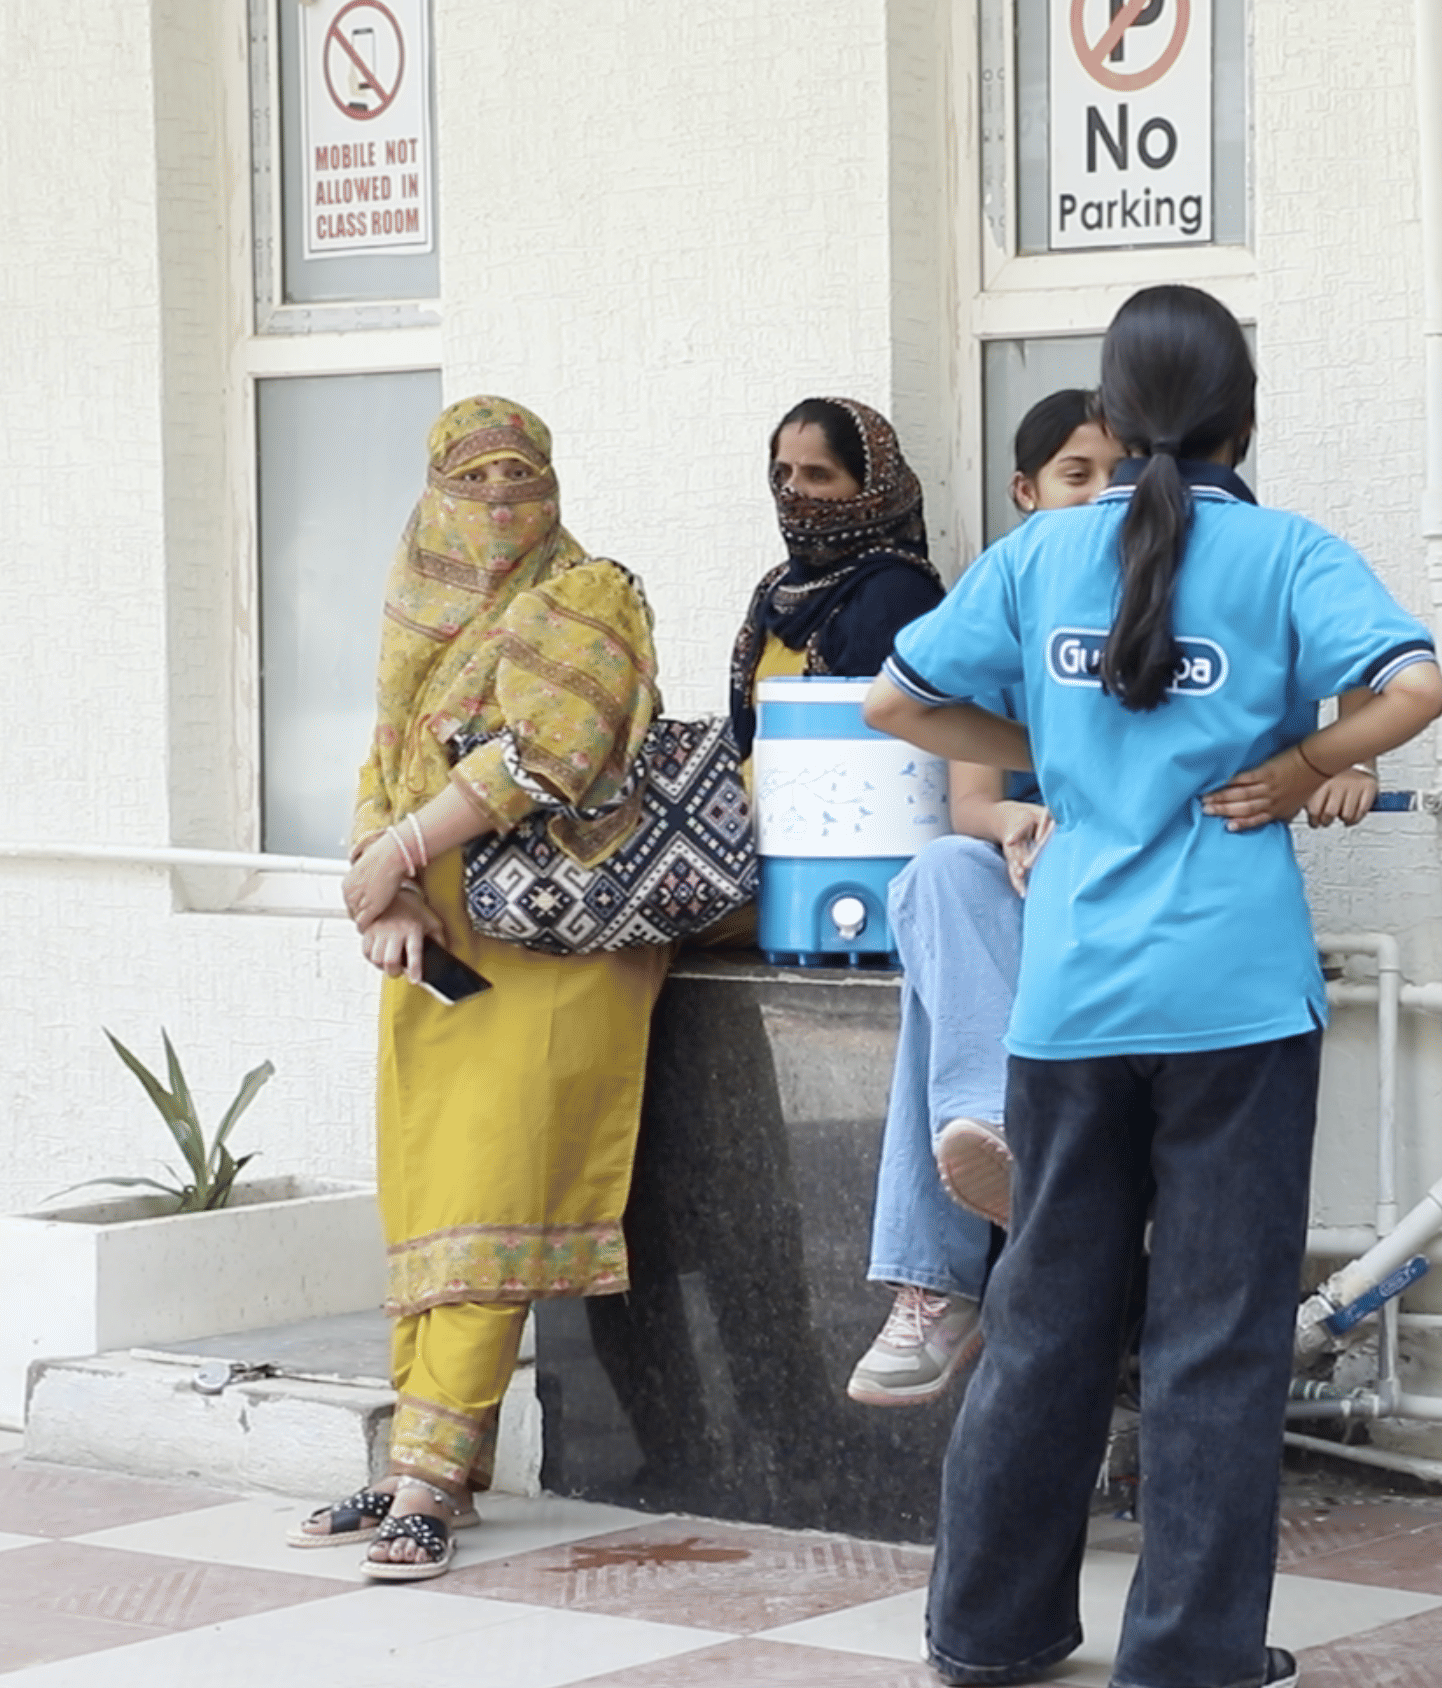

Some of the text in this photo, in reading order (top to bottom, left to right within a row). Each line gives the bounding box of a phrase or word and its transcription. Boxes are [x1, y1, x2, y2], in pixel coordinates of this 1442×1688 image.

[1086, 102, 1178, 173] No
[316, 138, 418, 171] MOBILE NOT
[316, 172, 419, 205] ALLOWED IN
[317, 208, 420, 240] CLASS ROOM
[1059, 187, 1202, 235] Parking
